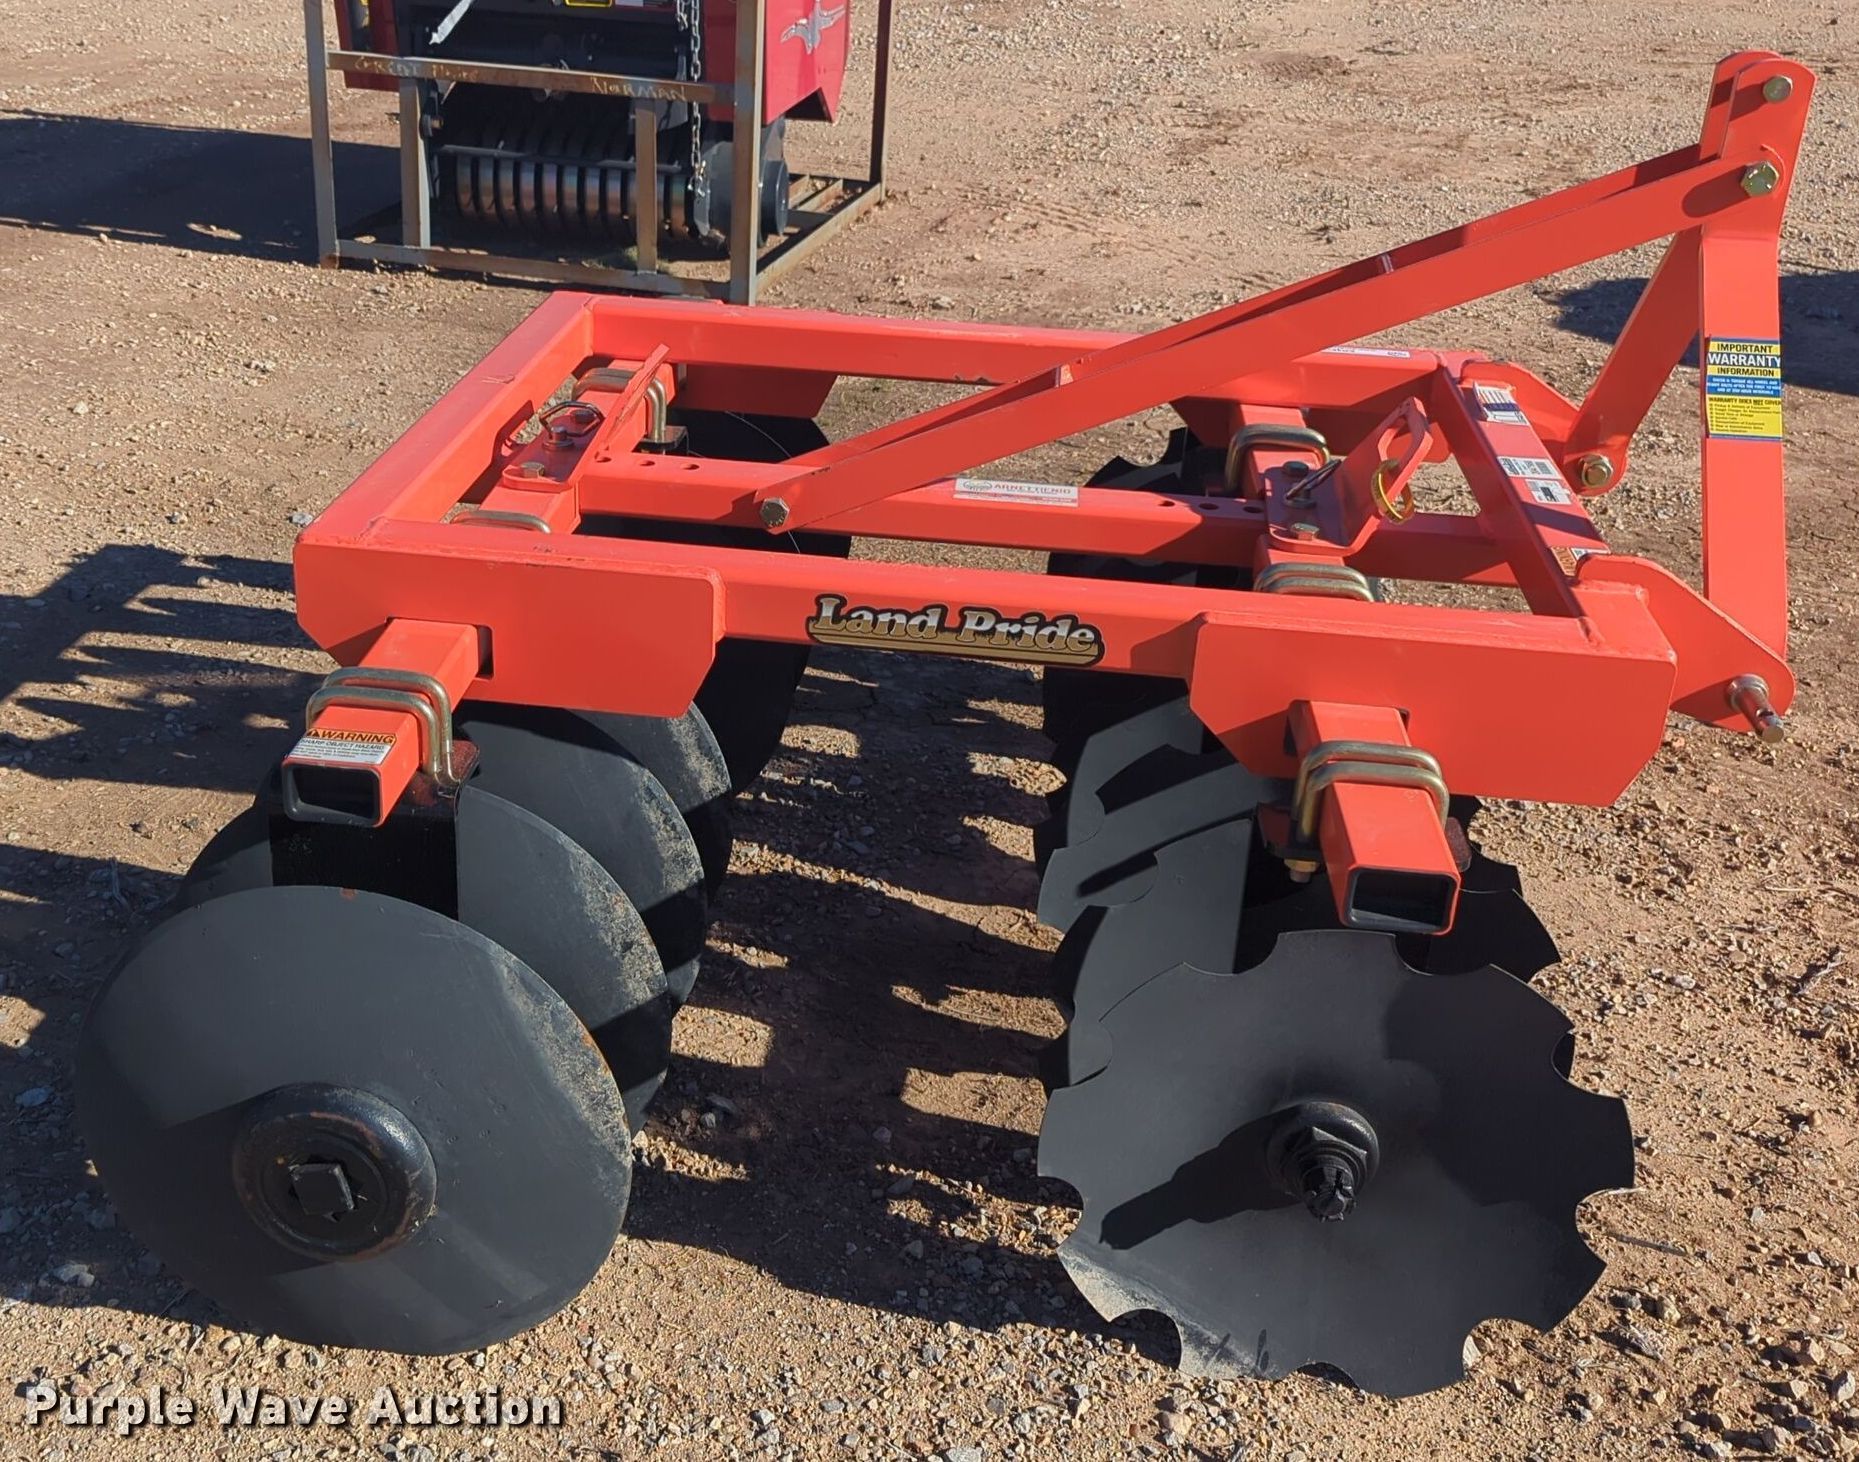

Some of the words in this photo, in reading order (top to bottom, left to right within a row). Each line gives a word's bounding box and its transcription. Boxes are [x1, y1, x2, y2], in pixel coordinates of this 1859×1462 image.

[1717, 343, 1773, 353] IMPORTANT
[1707, 353, 1780, 368] WARRANTY
[1717, 367, 1774, 377] INFORMATION
[814, 597, 942, 639] Land
[956, 610, 1096, 651] Pride
[321, 729, 394, 744] WARNING
[326, 740, 354, 748] OBJECT
